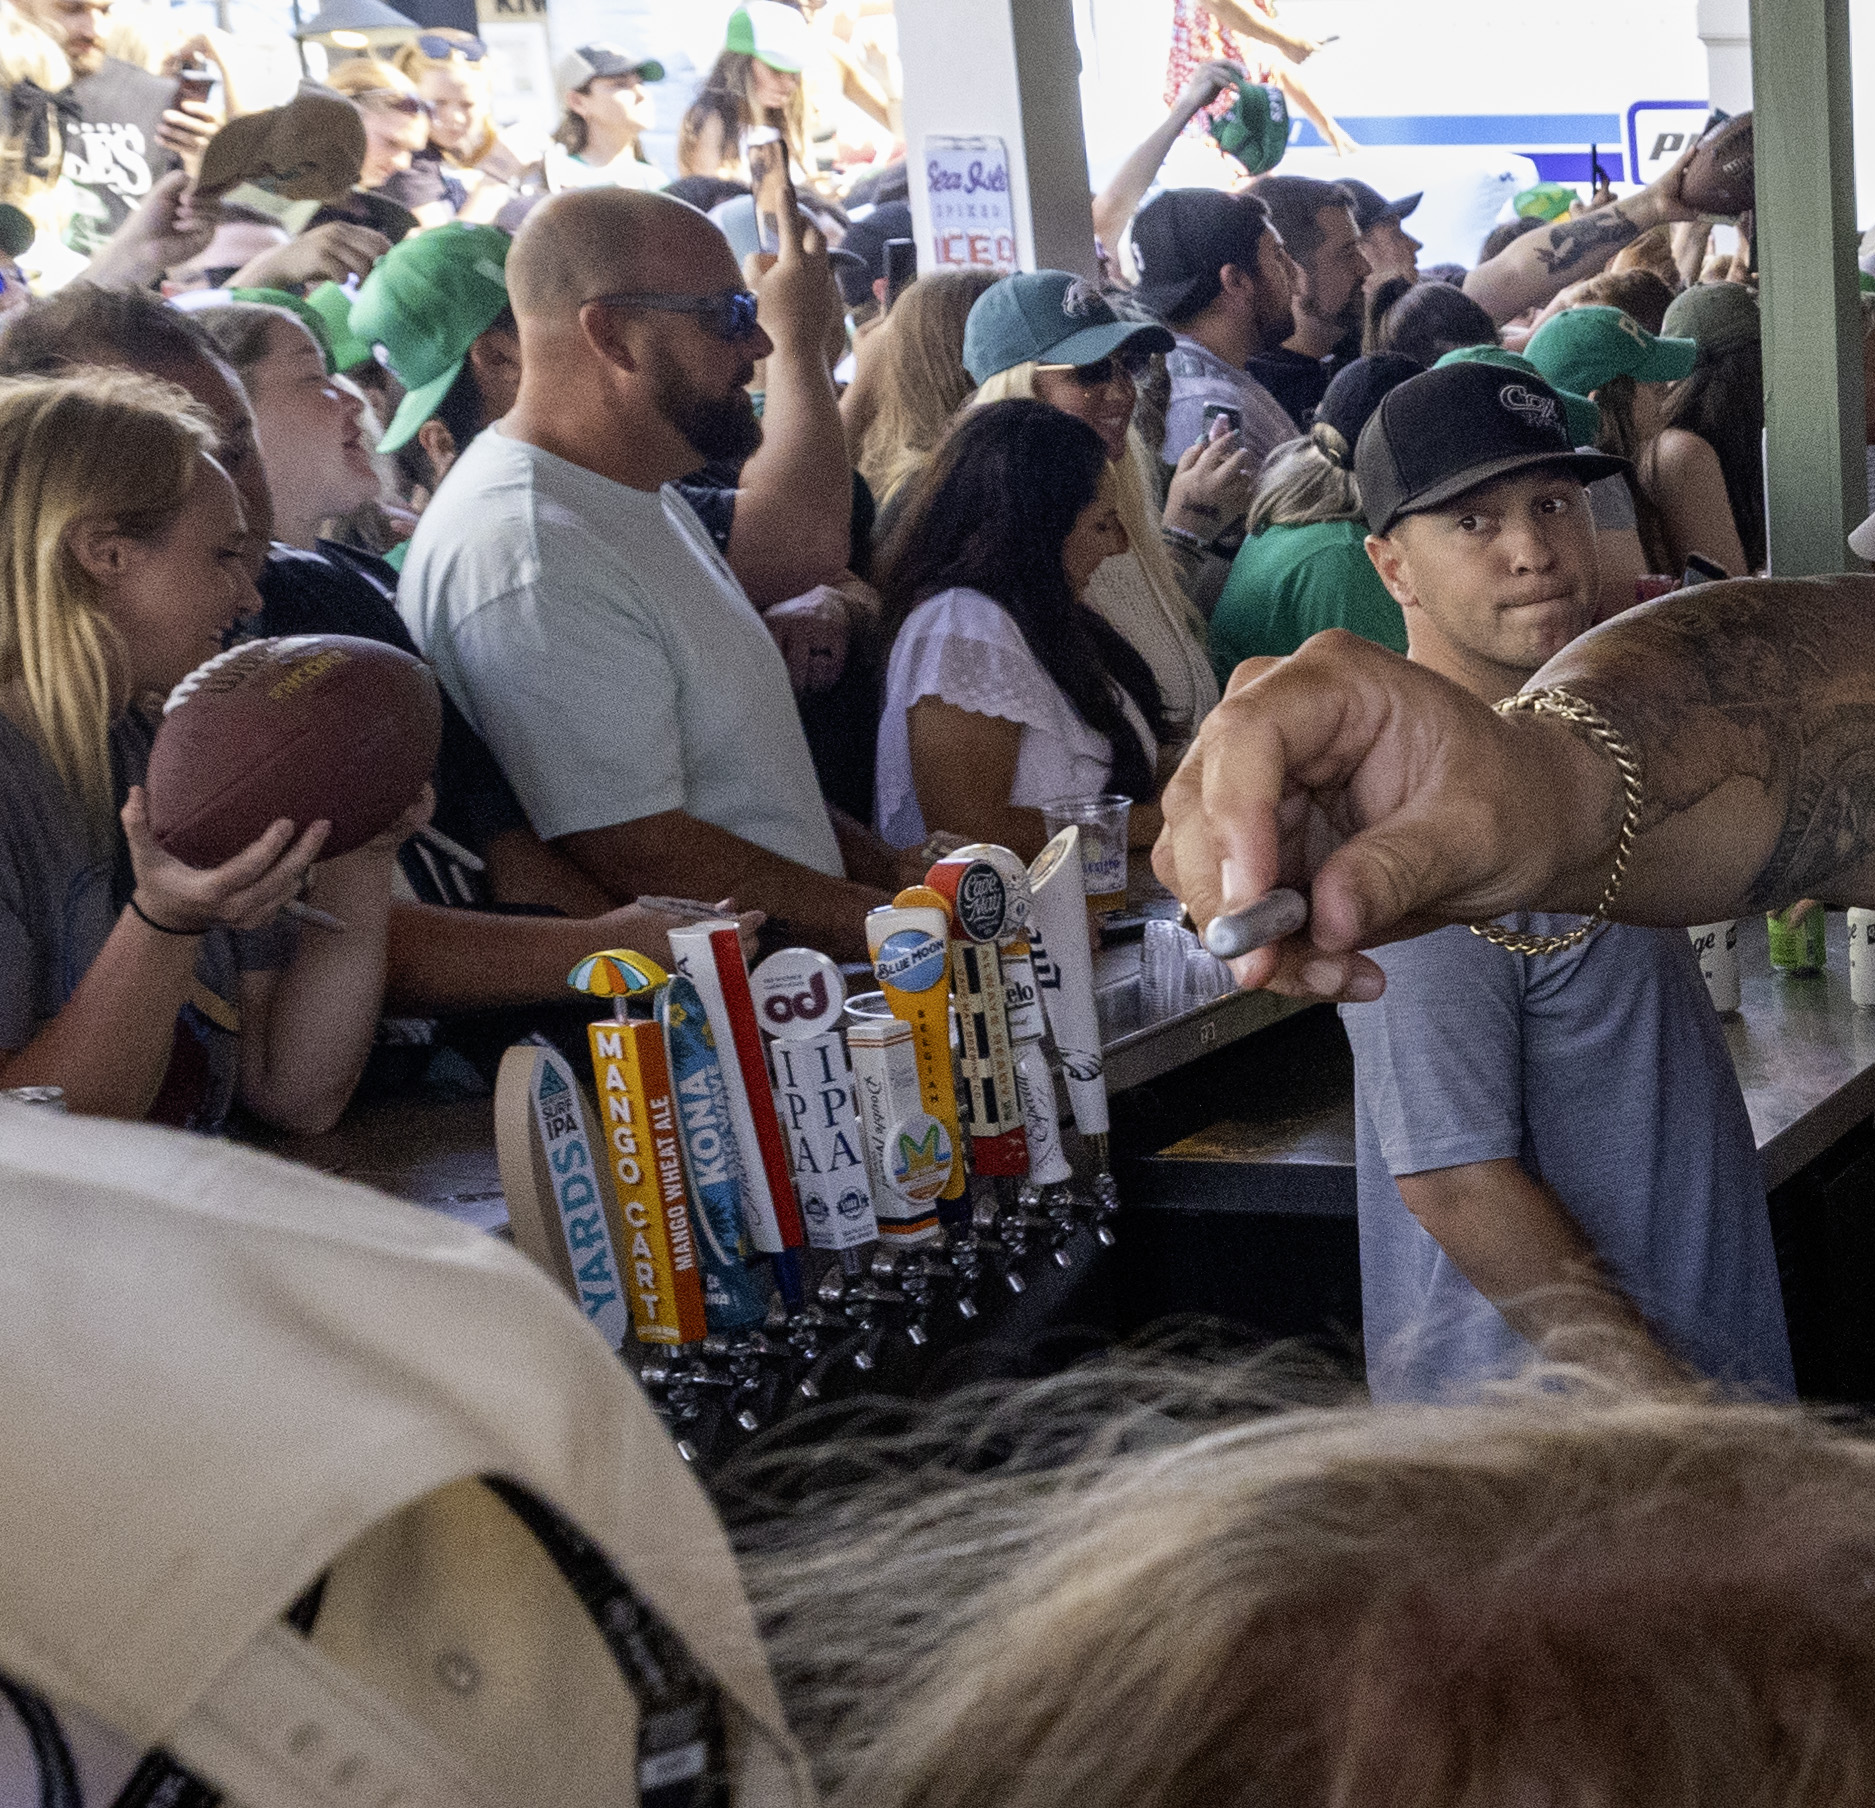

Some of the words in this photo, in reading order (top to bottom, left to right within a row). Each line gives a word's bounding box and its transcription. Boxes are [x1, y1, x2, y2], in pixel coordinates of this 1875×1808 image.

[927, 160, 962, 192] Sea
[876, 961, 910, 980] BLUE
[911, 939, 945, 965] MOON
[917, 1009, 940, 1103] BELGIAN
[545, 1113, 579, 1142] IPA
[649, 1094, 674, 1131] ALE
[678, 1068, 728, 1188] KONA
[814, 1045, 862, 1173] IPA
[595, 1031, 640, 1186] MANGO
[624, 1202, 658, 1321] CART
[655, 1136, 684, 1202] WHEAT
[551, 1139, 617, 1320] YARDS
[665, 1203, 694, 1273] MANGO
